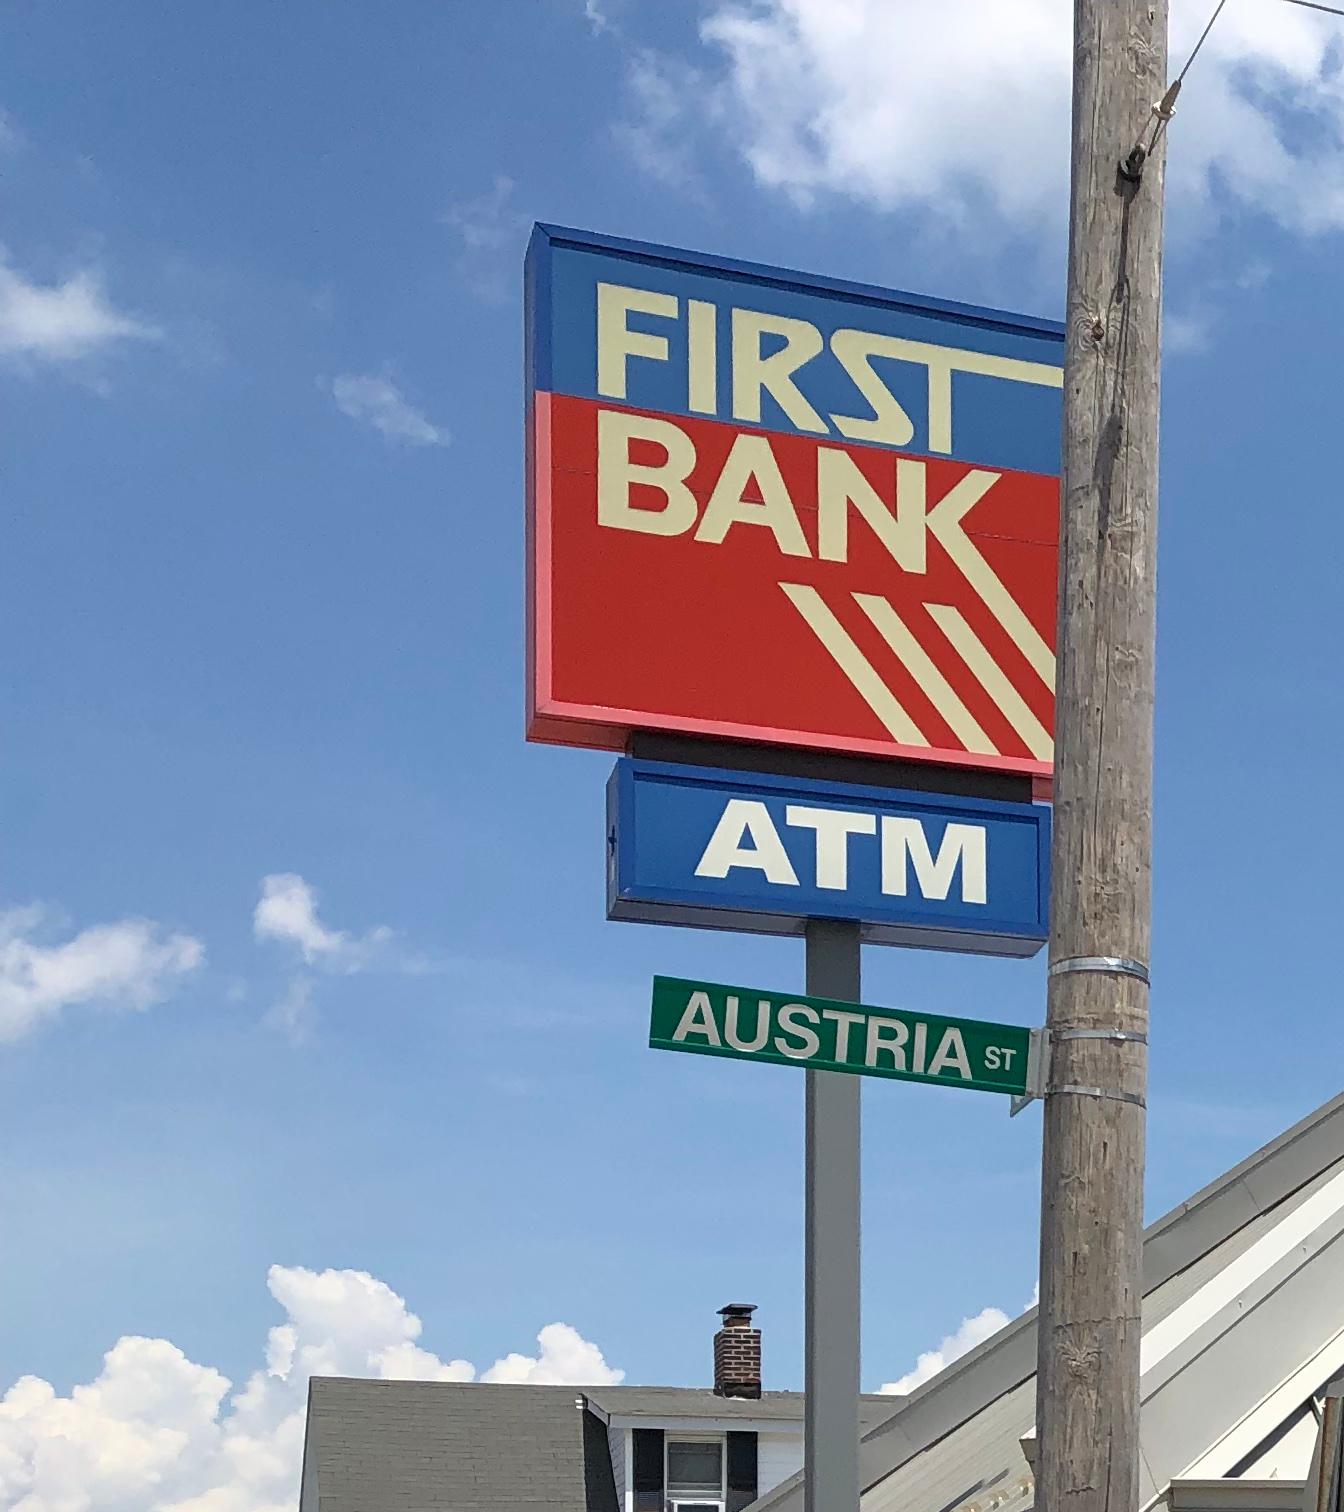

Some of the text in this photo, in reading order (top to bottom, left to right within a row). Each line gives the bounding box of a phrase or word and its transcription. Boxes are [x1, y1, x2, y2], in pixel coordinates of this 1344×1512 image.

[597, 282, 1065, 454] FIRST
[597, 410, 1003, 577] BANK
[694, 798, 988, 905] ATM
[672, 990, 1017, 1081] AUSTRIA ST
